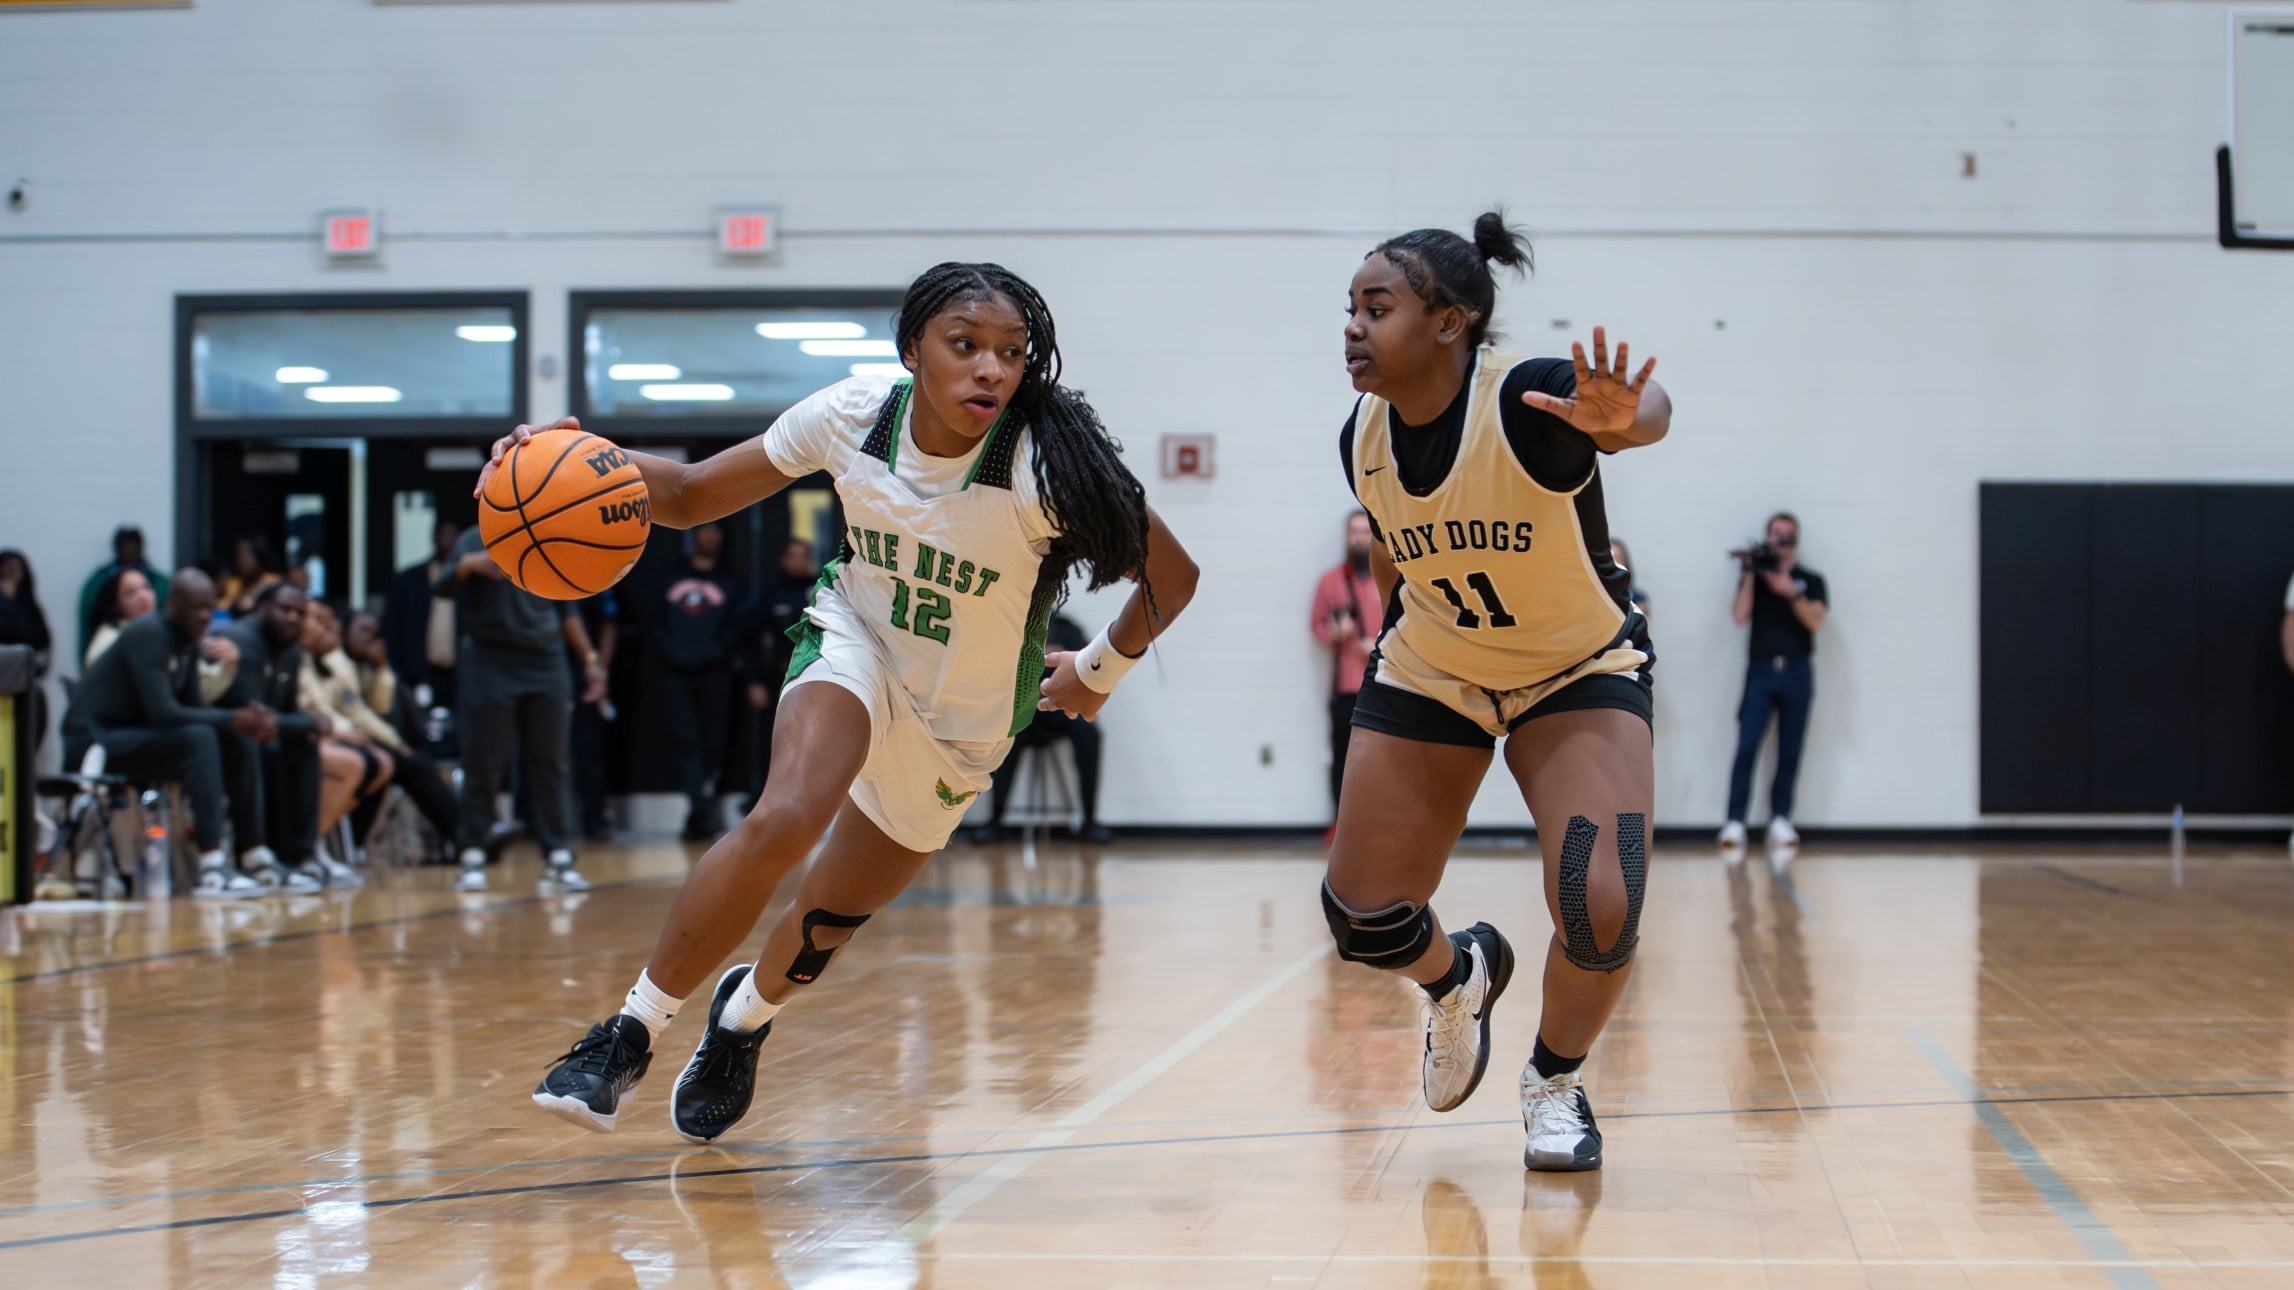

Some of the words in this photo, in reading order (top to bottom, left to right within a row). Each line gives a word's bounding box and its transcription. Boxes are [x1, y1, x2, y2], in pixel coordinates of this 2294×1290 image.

[586, 447, 633, 477] CAA
[598, 496, 651, 527] lson
[1384, 523, 1439, 563] ADY
[1445, 520, 1533, 552] DOGS
[914, 543, 1000, 597] NEST
[889, 576, 951, 646] 12
[1431, 571, 1518, 629] 11
